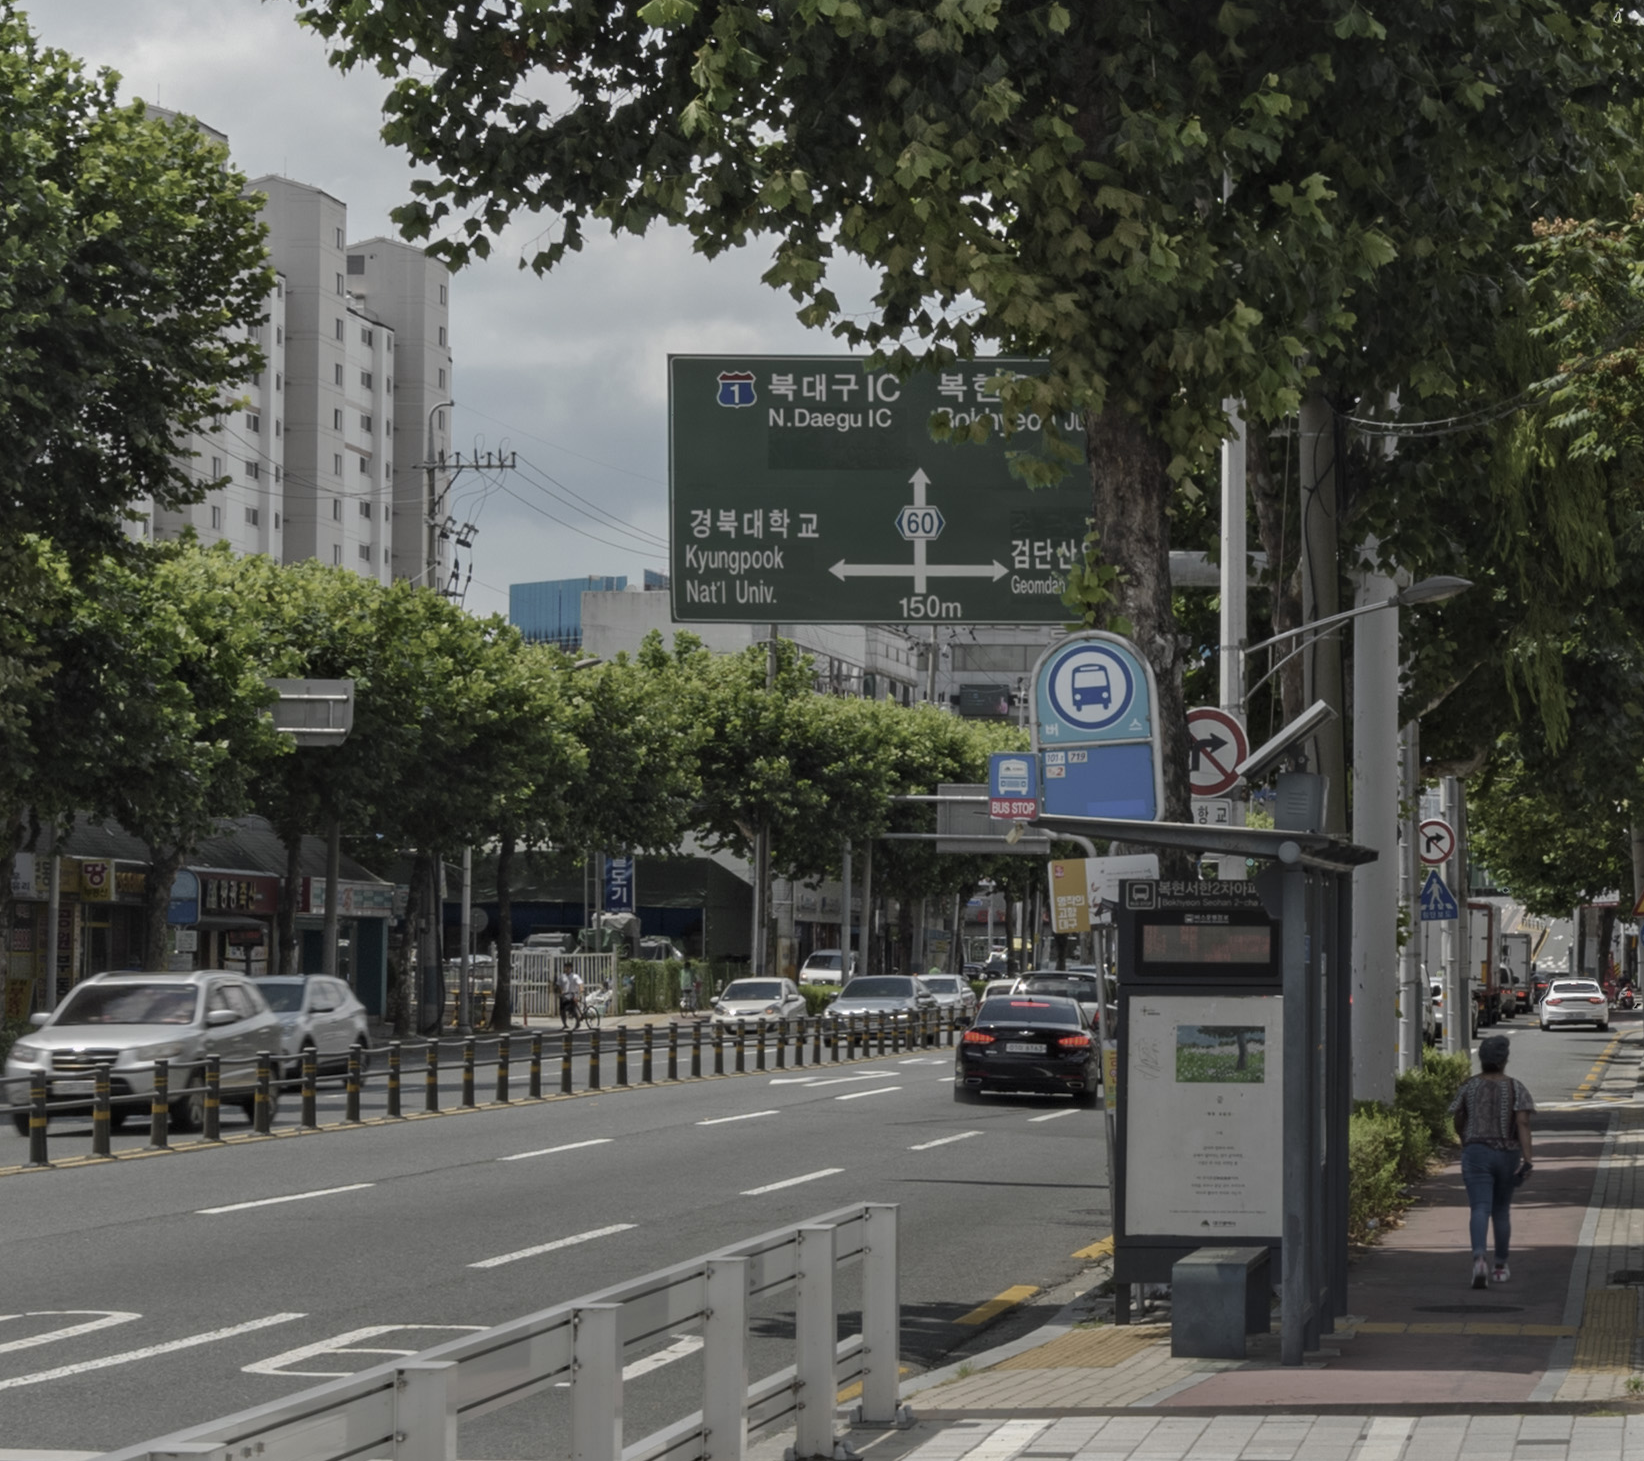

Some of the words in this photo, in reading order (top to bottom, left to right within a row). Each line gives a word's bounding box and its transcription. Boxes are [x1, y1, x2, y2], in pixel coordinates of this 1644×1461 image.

[730, 384, 740, 404] 1
[769, 408, 862, 432] N.Daegu
[868, 408, 892, 428] IC
[690, 508, 820, 539] 경북대학교
[907, 511, 935, 535] 60
[686, 545, 784, 575] Kyungpook
[686, 579, 727, 605] Nat'l
[735, 579, 778, 604] Univ.
[899, 596, 962, 618] 150m
[1071, 752, 1086, 761] 719
[991, 802, 1010, 815] BUS
[1012, 801, 1035, 815] STOP
[84, 863, 108, 886] 땅
[1162, 898, 1201, 908] Bokhyeon
[1202, 898, 1232, 907] Seohan
